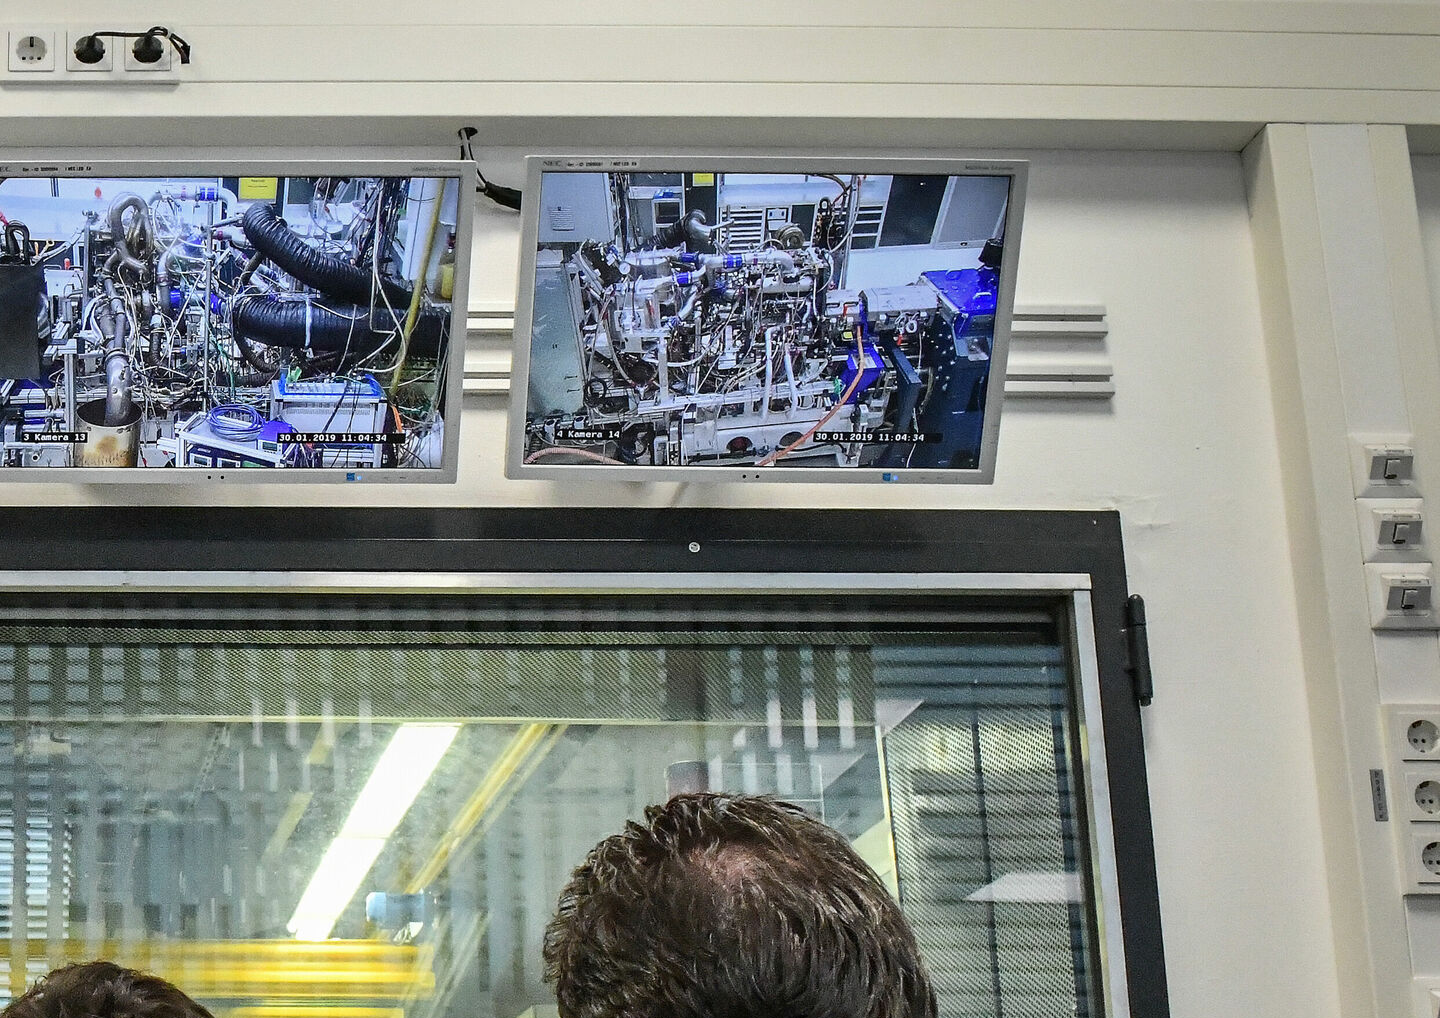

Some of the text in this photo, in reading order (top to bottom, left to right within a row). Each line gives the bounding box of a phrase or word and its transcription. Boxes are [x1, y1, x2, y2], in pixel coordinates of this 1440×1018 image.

[34, 433, 69, 441] Kamera
[74, 433, 86, 441] 13
[279, 434, 387, 442] 30.01.2019 11:04:34
[567, 430, 603, 438] Kamera
[608, 430, 620, 438] 14
[815, 432, 925, 441] 30.01.2019 11:04:34
